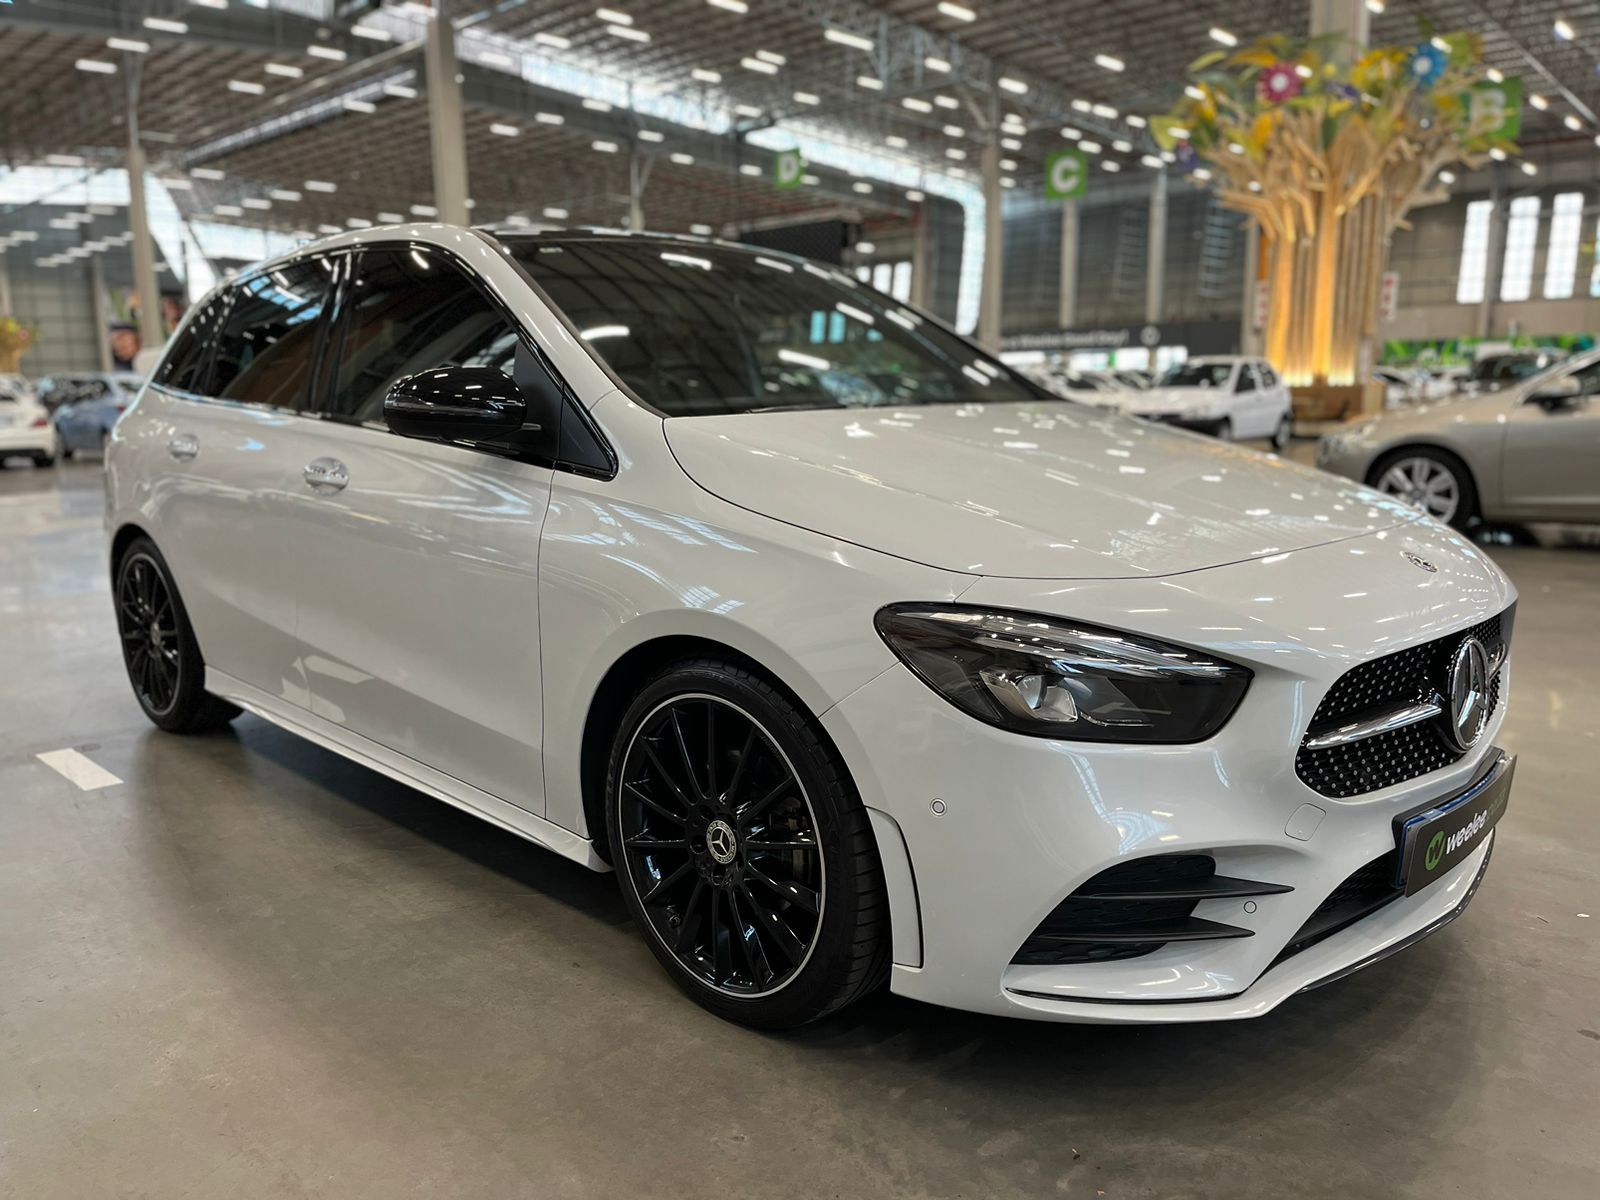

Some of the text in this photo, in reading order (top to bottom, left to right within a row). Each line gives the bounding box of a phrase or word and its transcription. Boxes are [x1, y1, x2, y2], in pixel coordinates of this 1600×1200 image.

[1469, 88, 1506, 132] B
[778, 152, 799, 183] D
[1050, 155, 1081, 192] C
[1446, 809, 1488, 855] weelee
